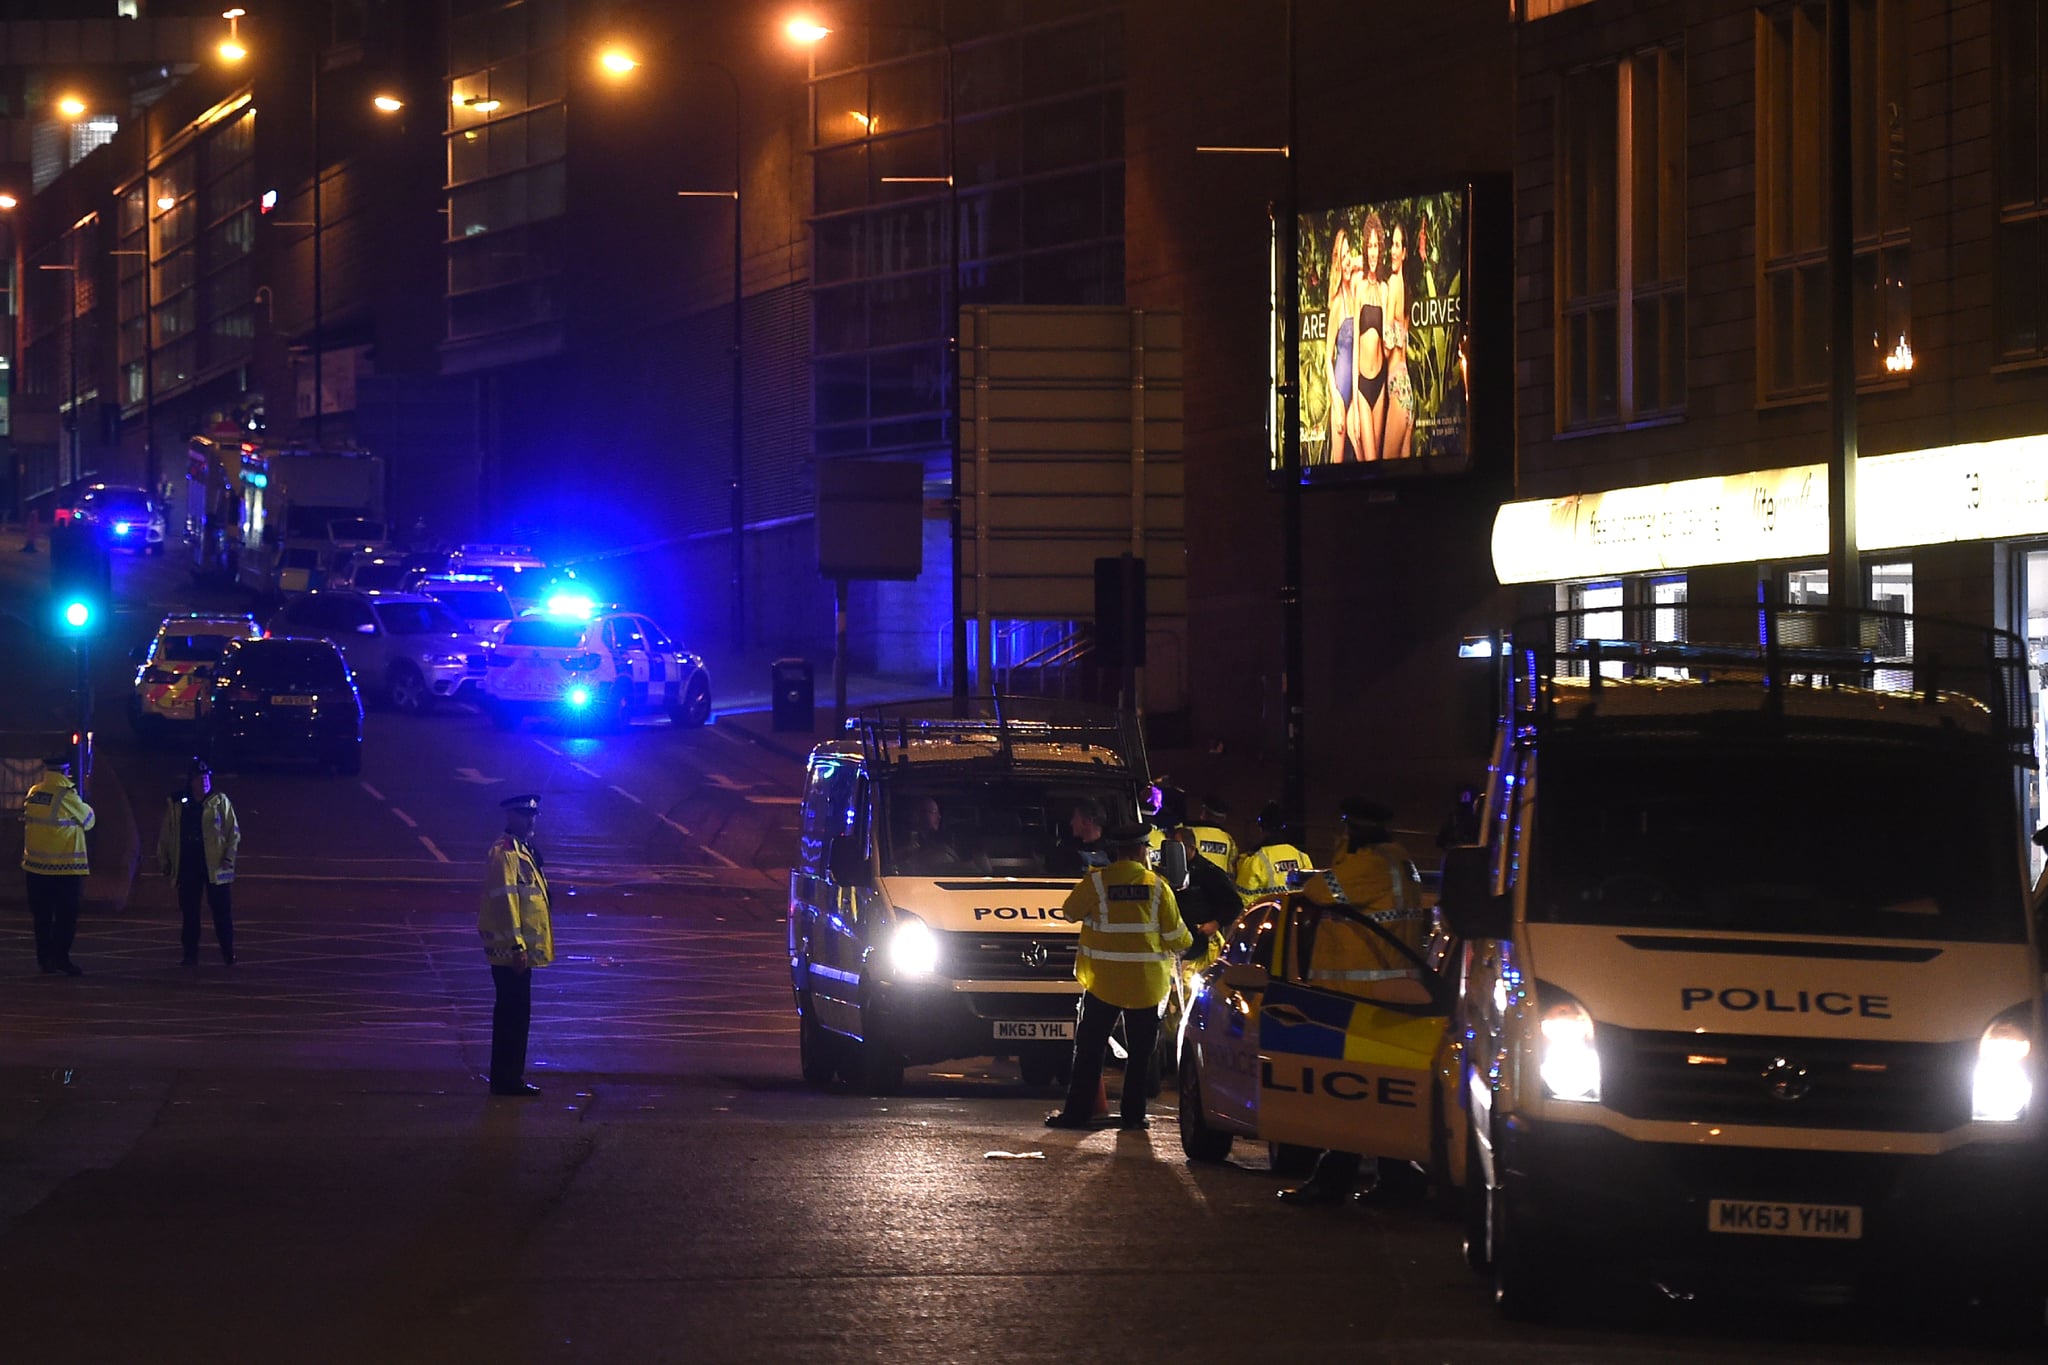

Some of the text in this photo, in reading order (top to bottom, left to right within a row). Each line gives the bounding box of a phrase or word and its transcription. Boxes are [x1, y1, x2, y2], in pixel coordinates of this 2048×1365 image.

[1302, 313, 1326, 340] ARE
[1411, 297, 1461, 328] CURVES
[973, 906, 1066, 921] POLIC
[1680, 987, 1892, 1019] POLICE
[999, 1023, 1067, 1037] MK63 YHL
[1262, 1061, 1417, 1108] LICE
[1719, 1203, 1851, 1233] MK63 YHM
